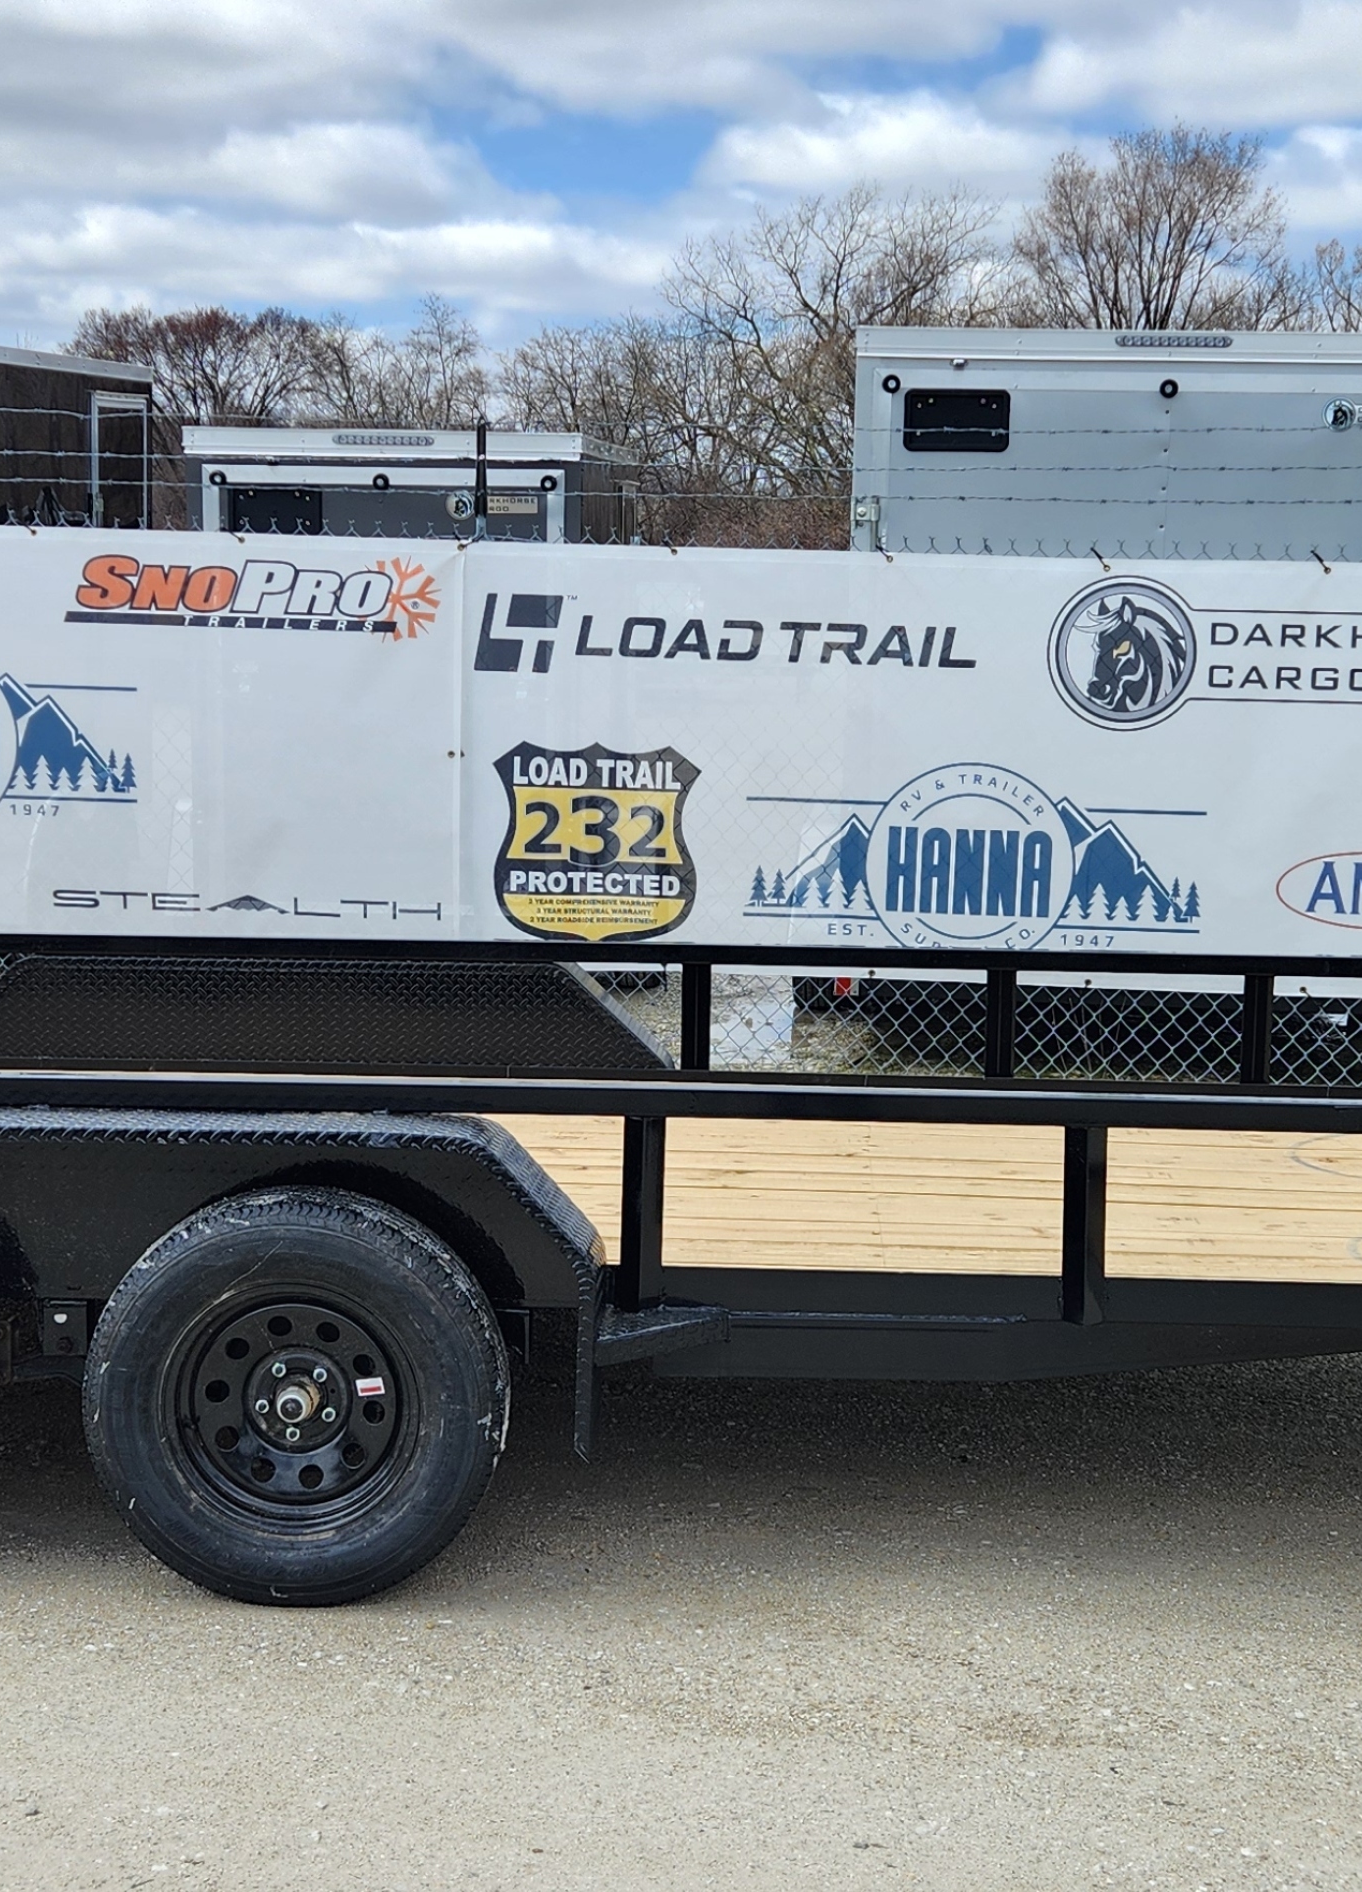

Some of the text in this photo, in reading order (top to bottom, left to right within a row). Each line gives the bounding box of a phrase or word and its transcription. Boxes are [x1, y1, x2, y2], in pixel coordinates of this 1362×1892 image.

[182, 615, 375, 632] TRAILERS
[575, 615, 978, 669] LOAD TRAIL
[513, 755, 681, 791] LOAD TRAIL
[10, 803, 61, 818] 1947
[900, 774, 1045, 817] RV & TRAILER
[523, 796, 667, 866] 232
[509, 871, 681, 897] PROTECTED
[886, 826, 1052, 917] HANNA
[52, 889, 441, 921] STEALTH
[596, 917, 658, 925] REIMBURSEMENT
[827, 923, 874, 937] EST.
[1060, 933, 1114, 947] 1947
